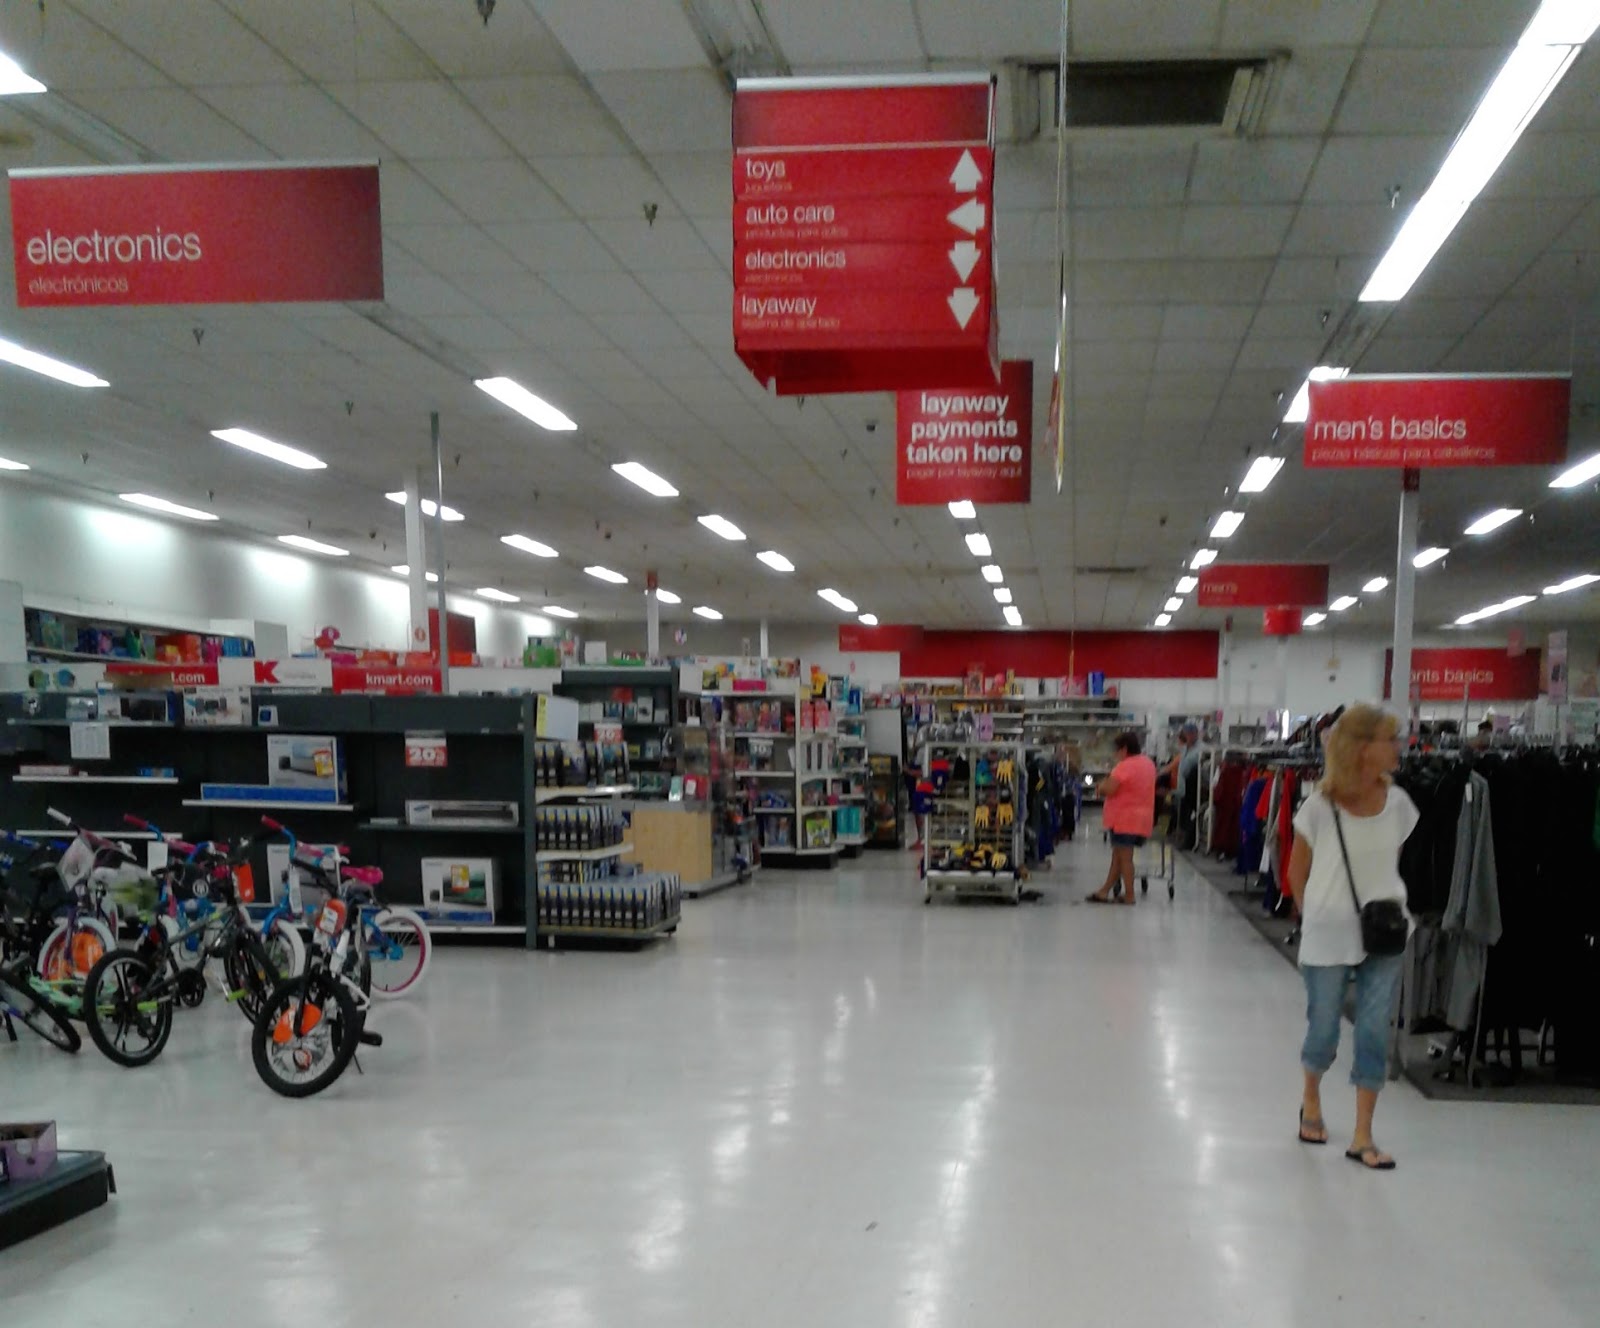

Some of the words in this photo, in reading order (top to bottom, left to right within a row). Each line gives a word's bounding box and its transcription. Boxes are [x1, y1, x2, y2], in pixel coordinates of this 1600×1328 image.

[746, 158, 785, 181] toys
[746, 203, 789, 225] auto
[793, 204, 835, 224] care
[27, 226, 202, 265] electronics
[745, 246, 847, 270] electronics
[28, 274, 129, 295] electrónicos
[741, 293, 818, 319] layaway
[920, 391, 1010, 417] layaway
[911, 417, 1018, 444] payments
[1313, 415, 1384, 442] men's
[1390, 414, 1467, 440] basics
[906, 442, 968, 465] taken
[973, 441, 1023, 464] here
[365, 673, 433, 686] kmart.com
[1444, 666, 1494, 684] basics
